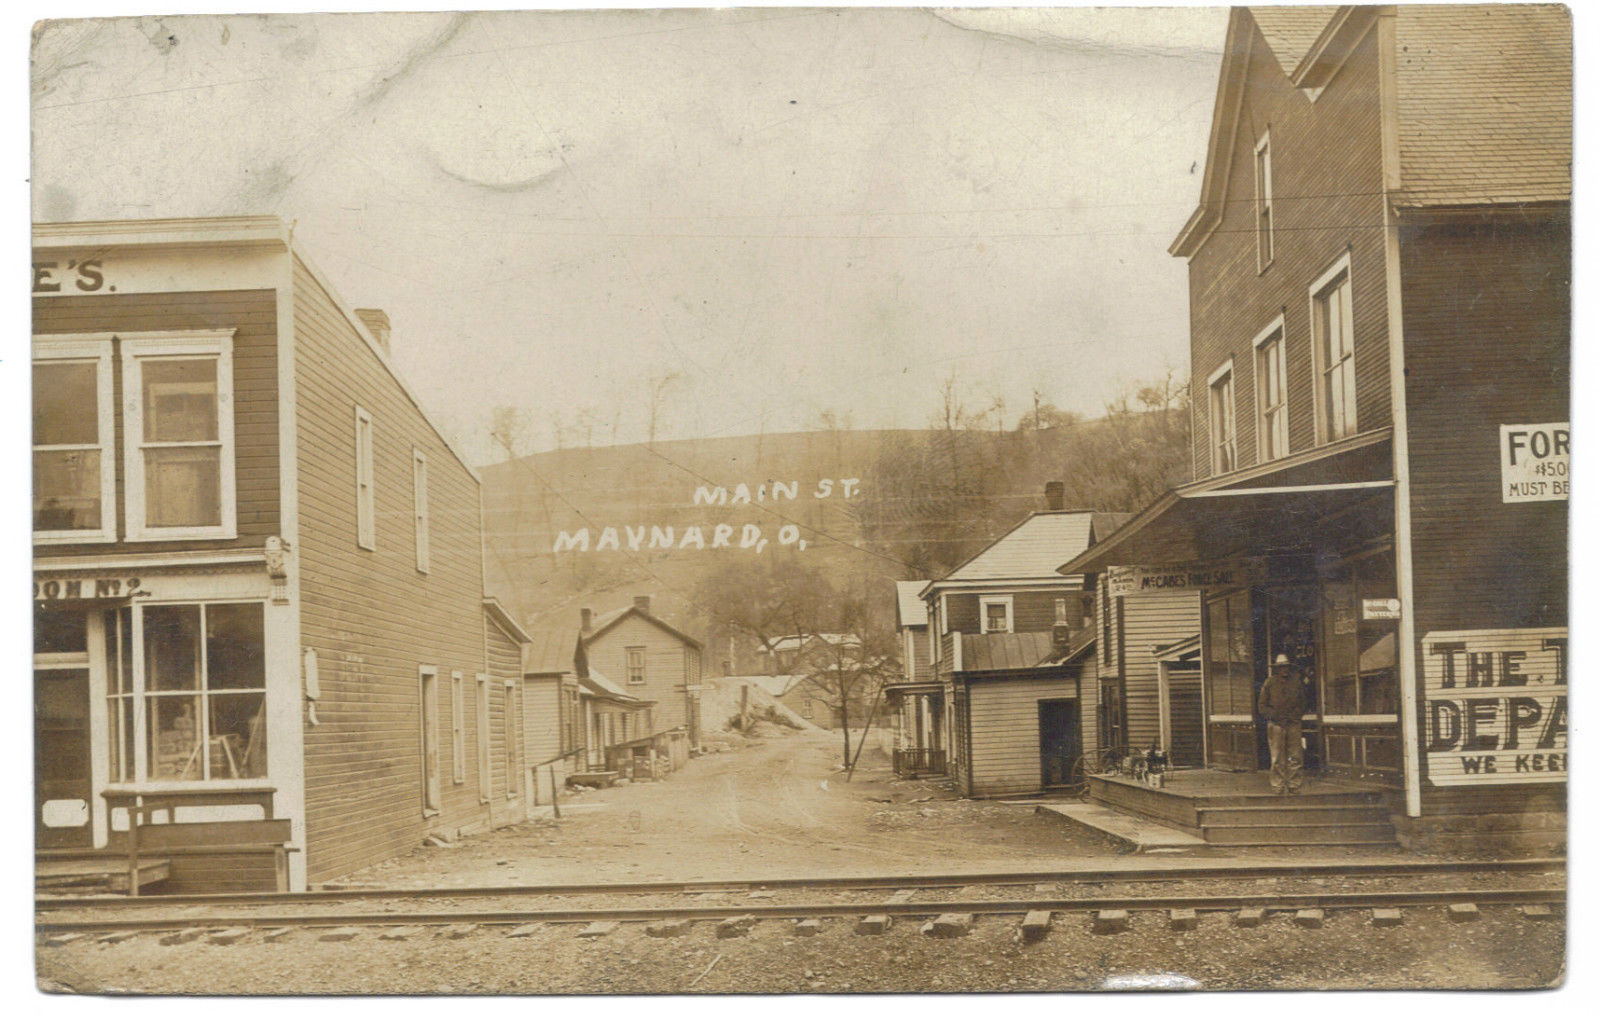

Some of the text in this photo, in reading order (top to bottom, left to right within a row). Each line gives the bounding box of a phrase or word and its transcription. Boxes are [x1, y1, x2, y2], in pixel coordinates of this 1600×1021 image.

[1508, 429, 1570, 466] FOR
[1508, 481, 1548, 497] MUST
[1430, 642, 1528, 690] THE
[1461, 756, 1498, 775] WE
